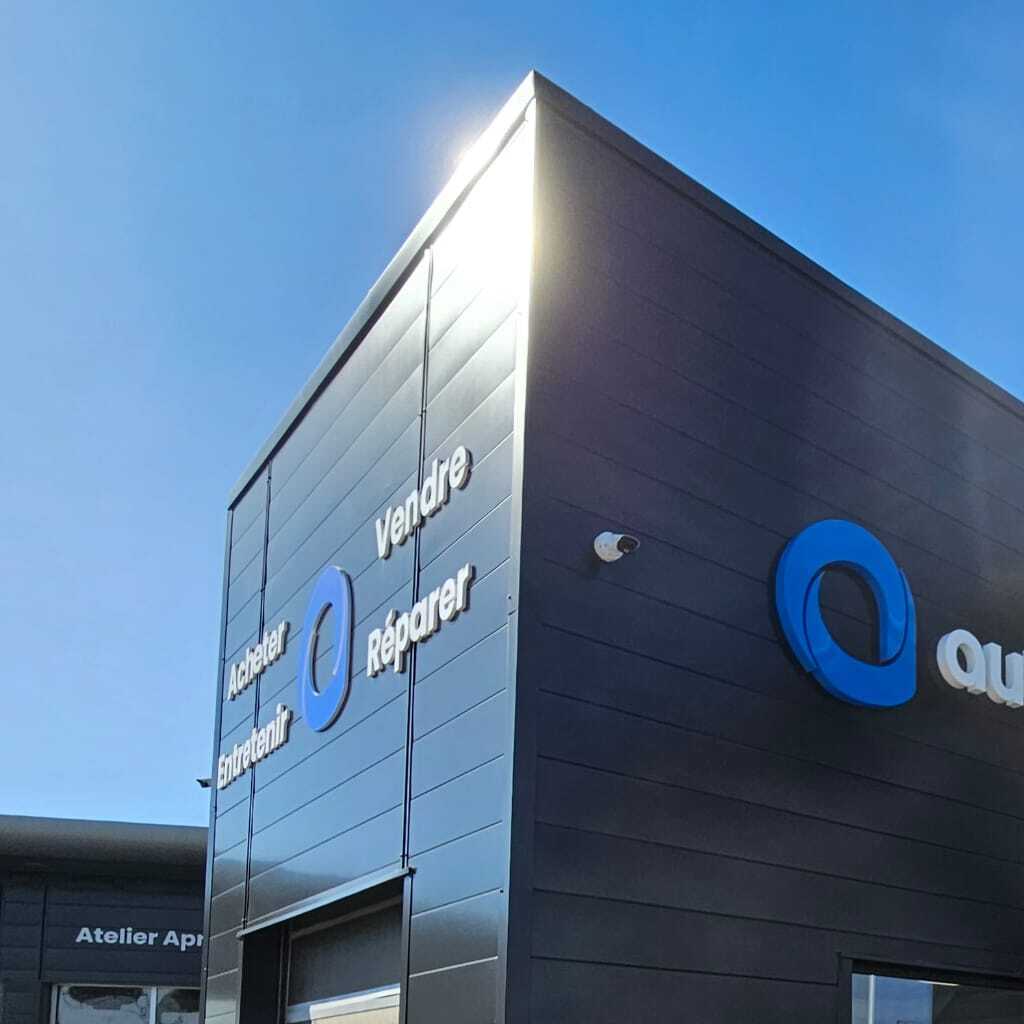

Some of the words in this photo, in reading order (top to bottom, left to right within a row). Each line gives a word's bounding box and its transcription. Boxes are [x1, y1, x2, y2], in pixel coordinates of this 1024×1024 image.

[375, 445, 471, 560] Vendre
[227, 619, 289, 701] Acheter
[366, 562, 474, 678] Réparer
[217, 702, 292, 790] Entretenir
[75, 926, 158, 945] Atelier
